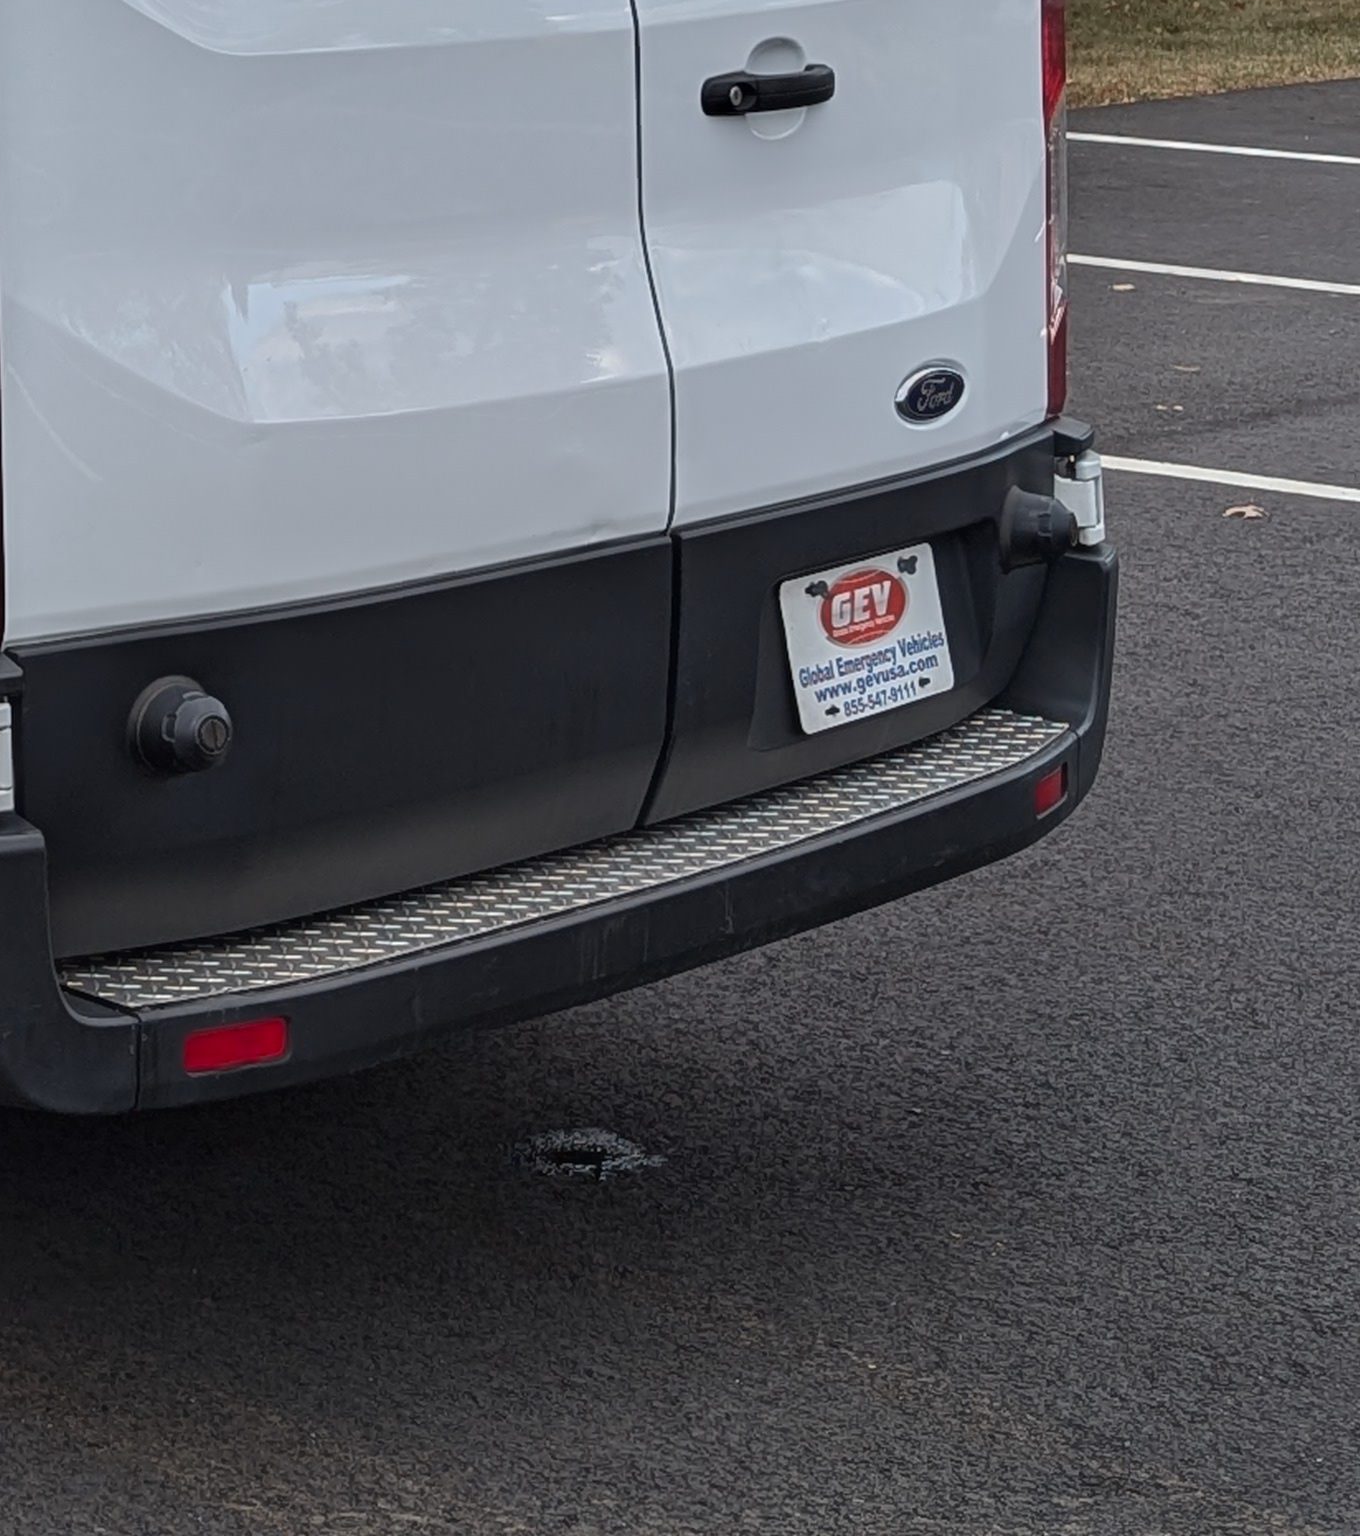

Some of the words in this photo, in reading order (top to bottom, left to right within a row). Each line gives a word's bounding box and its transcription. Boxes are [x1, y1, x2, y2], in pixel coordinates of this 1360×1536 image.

[916, 376, 956, 412] Ford
[830, 579, 892, 629] GEV
[798, 658, 836, 689] Global
[835, 645, 898, 678] Emergency
[896, 630, 946, 658] Vehicles
[813, 653, 940, 704] www.gevusa.com
[842, 680, 918, 718] 855-547-9111
